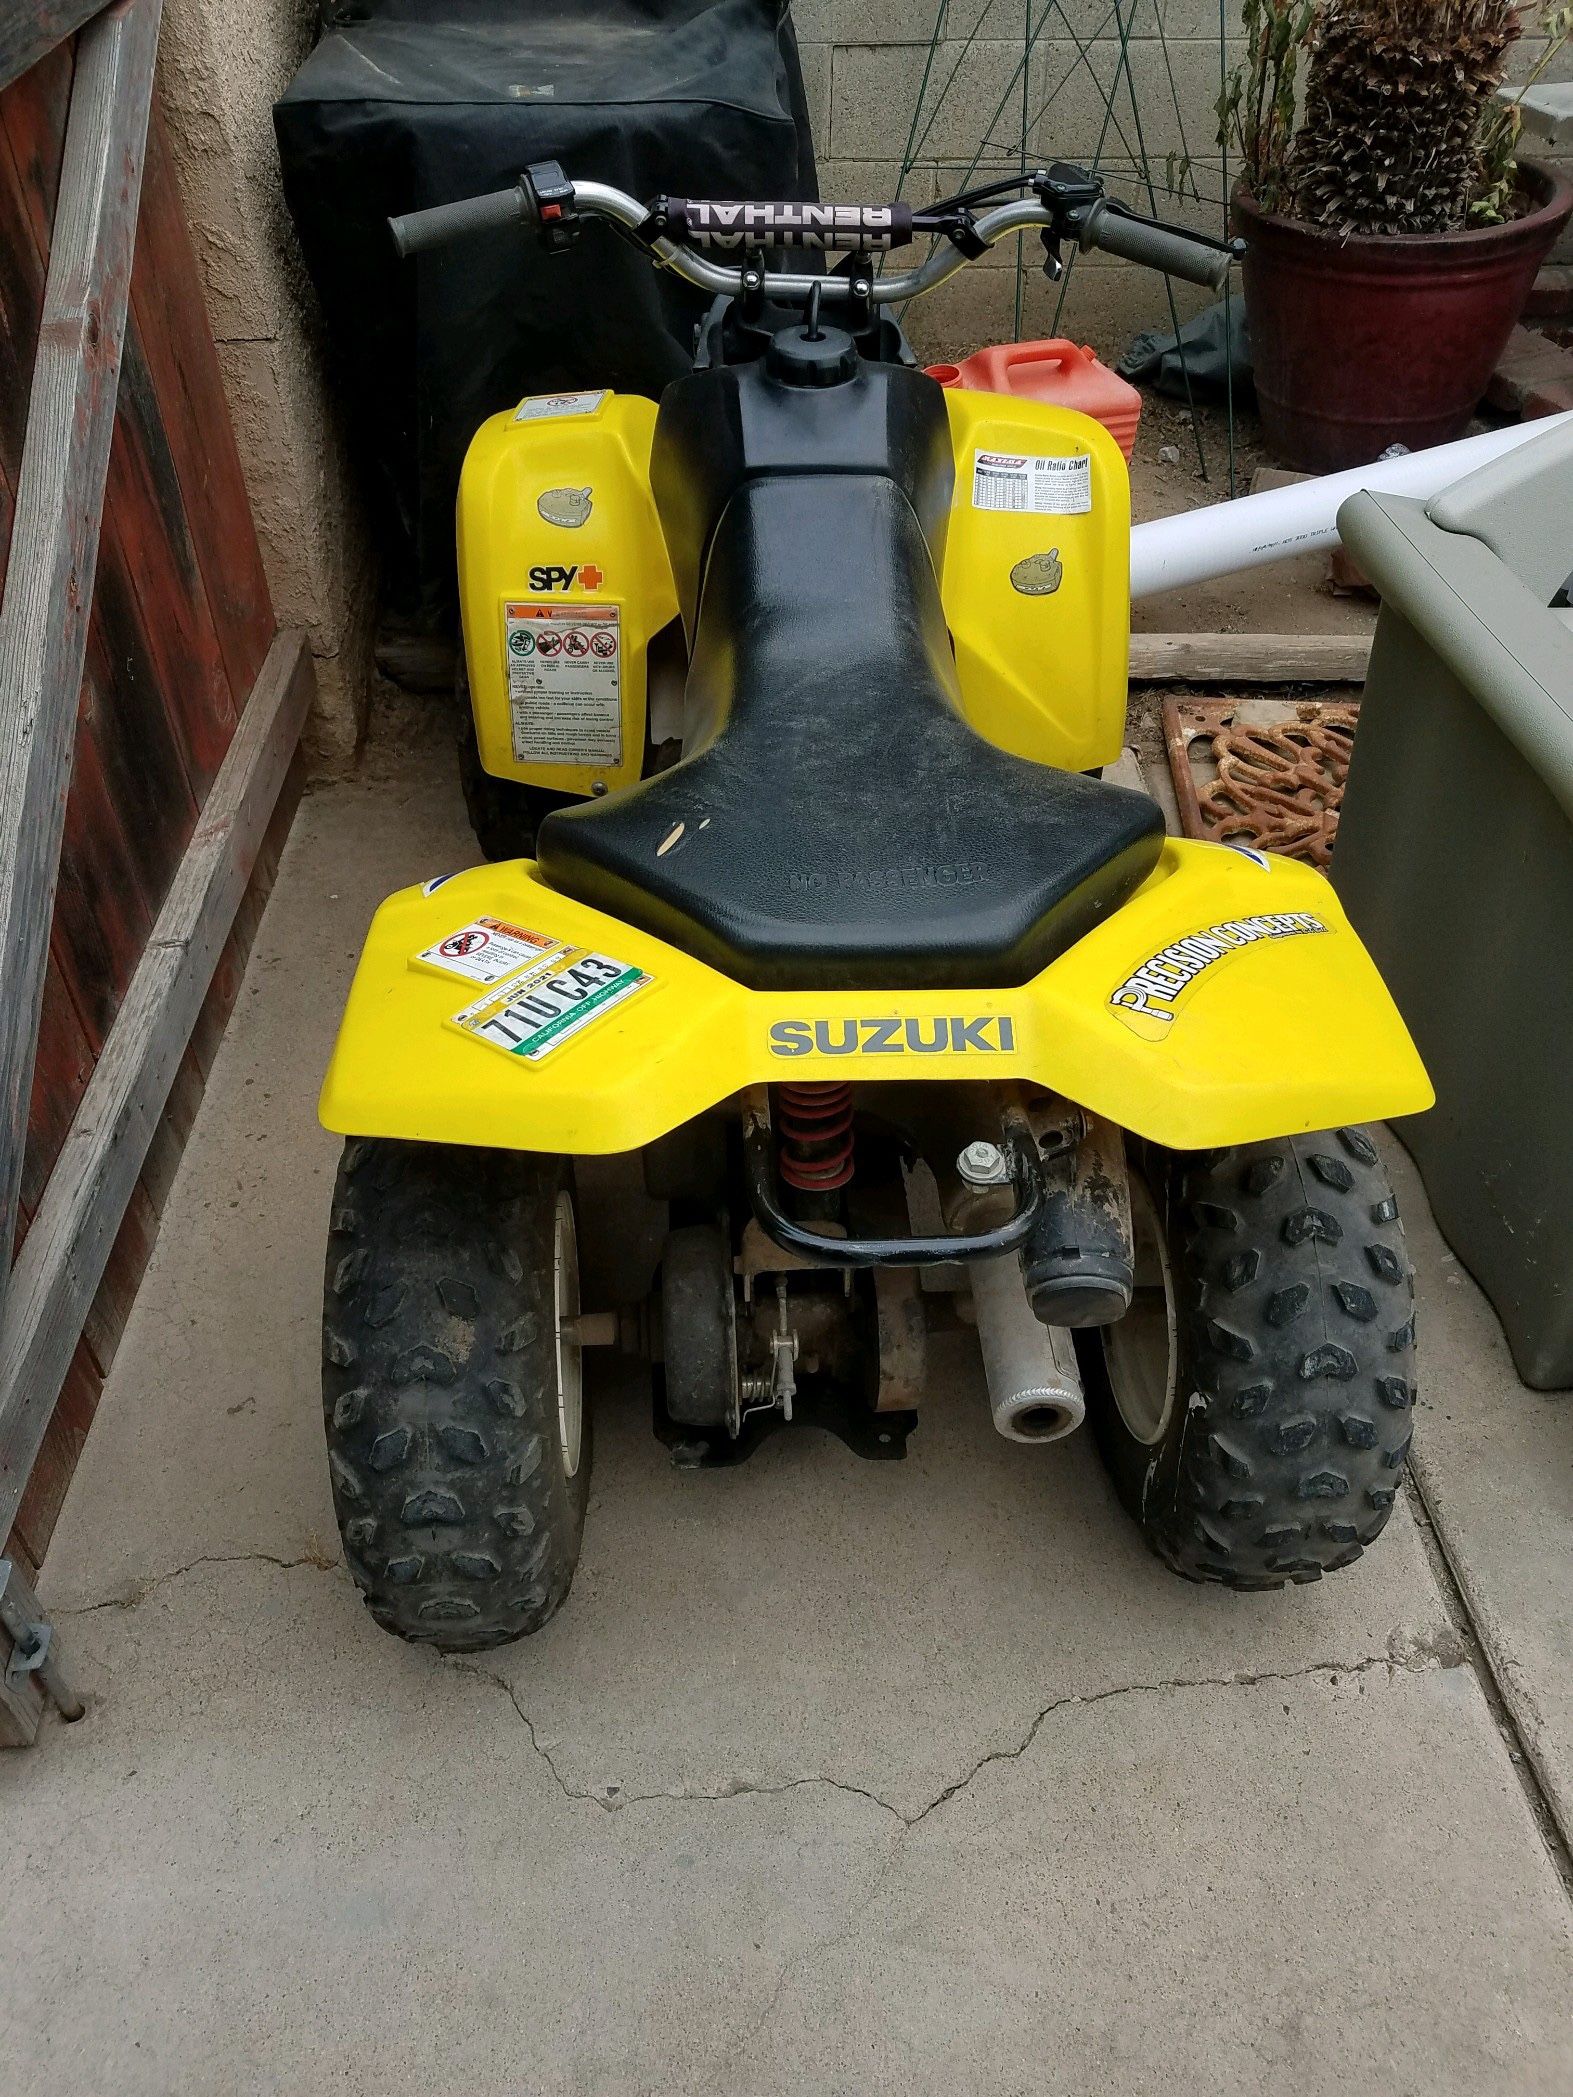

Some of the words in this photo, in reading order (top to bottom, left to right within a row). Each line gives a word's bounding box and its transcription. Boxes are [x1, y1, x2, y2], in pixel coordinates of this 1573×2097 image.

[687, 203, 892, 227] RENTHAL
[1035, 459, 1045, 471] Oil
[1047, 460, 1066, 471] Ratio
[1068, 457, 1088, 471] Chart
[501, 925, 540, 944] WARNING
[1110, 929, 1237, 1021] PRECISION
[1208, 911, 1325, 947] CONCEPTS
[481, 994, 562, 1043] 71U
[546, 958, 622, 1001] C43
[506, 988, 526, 1003] JUN
[526, 972, 553, 989] 2021
[531, 1012, 577, 1043] CALIFORNIA
[576, 1000, 592, 1012] OFF
[769, 1016, 1015, 1057] SUZUKI
